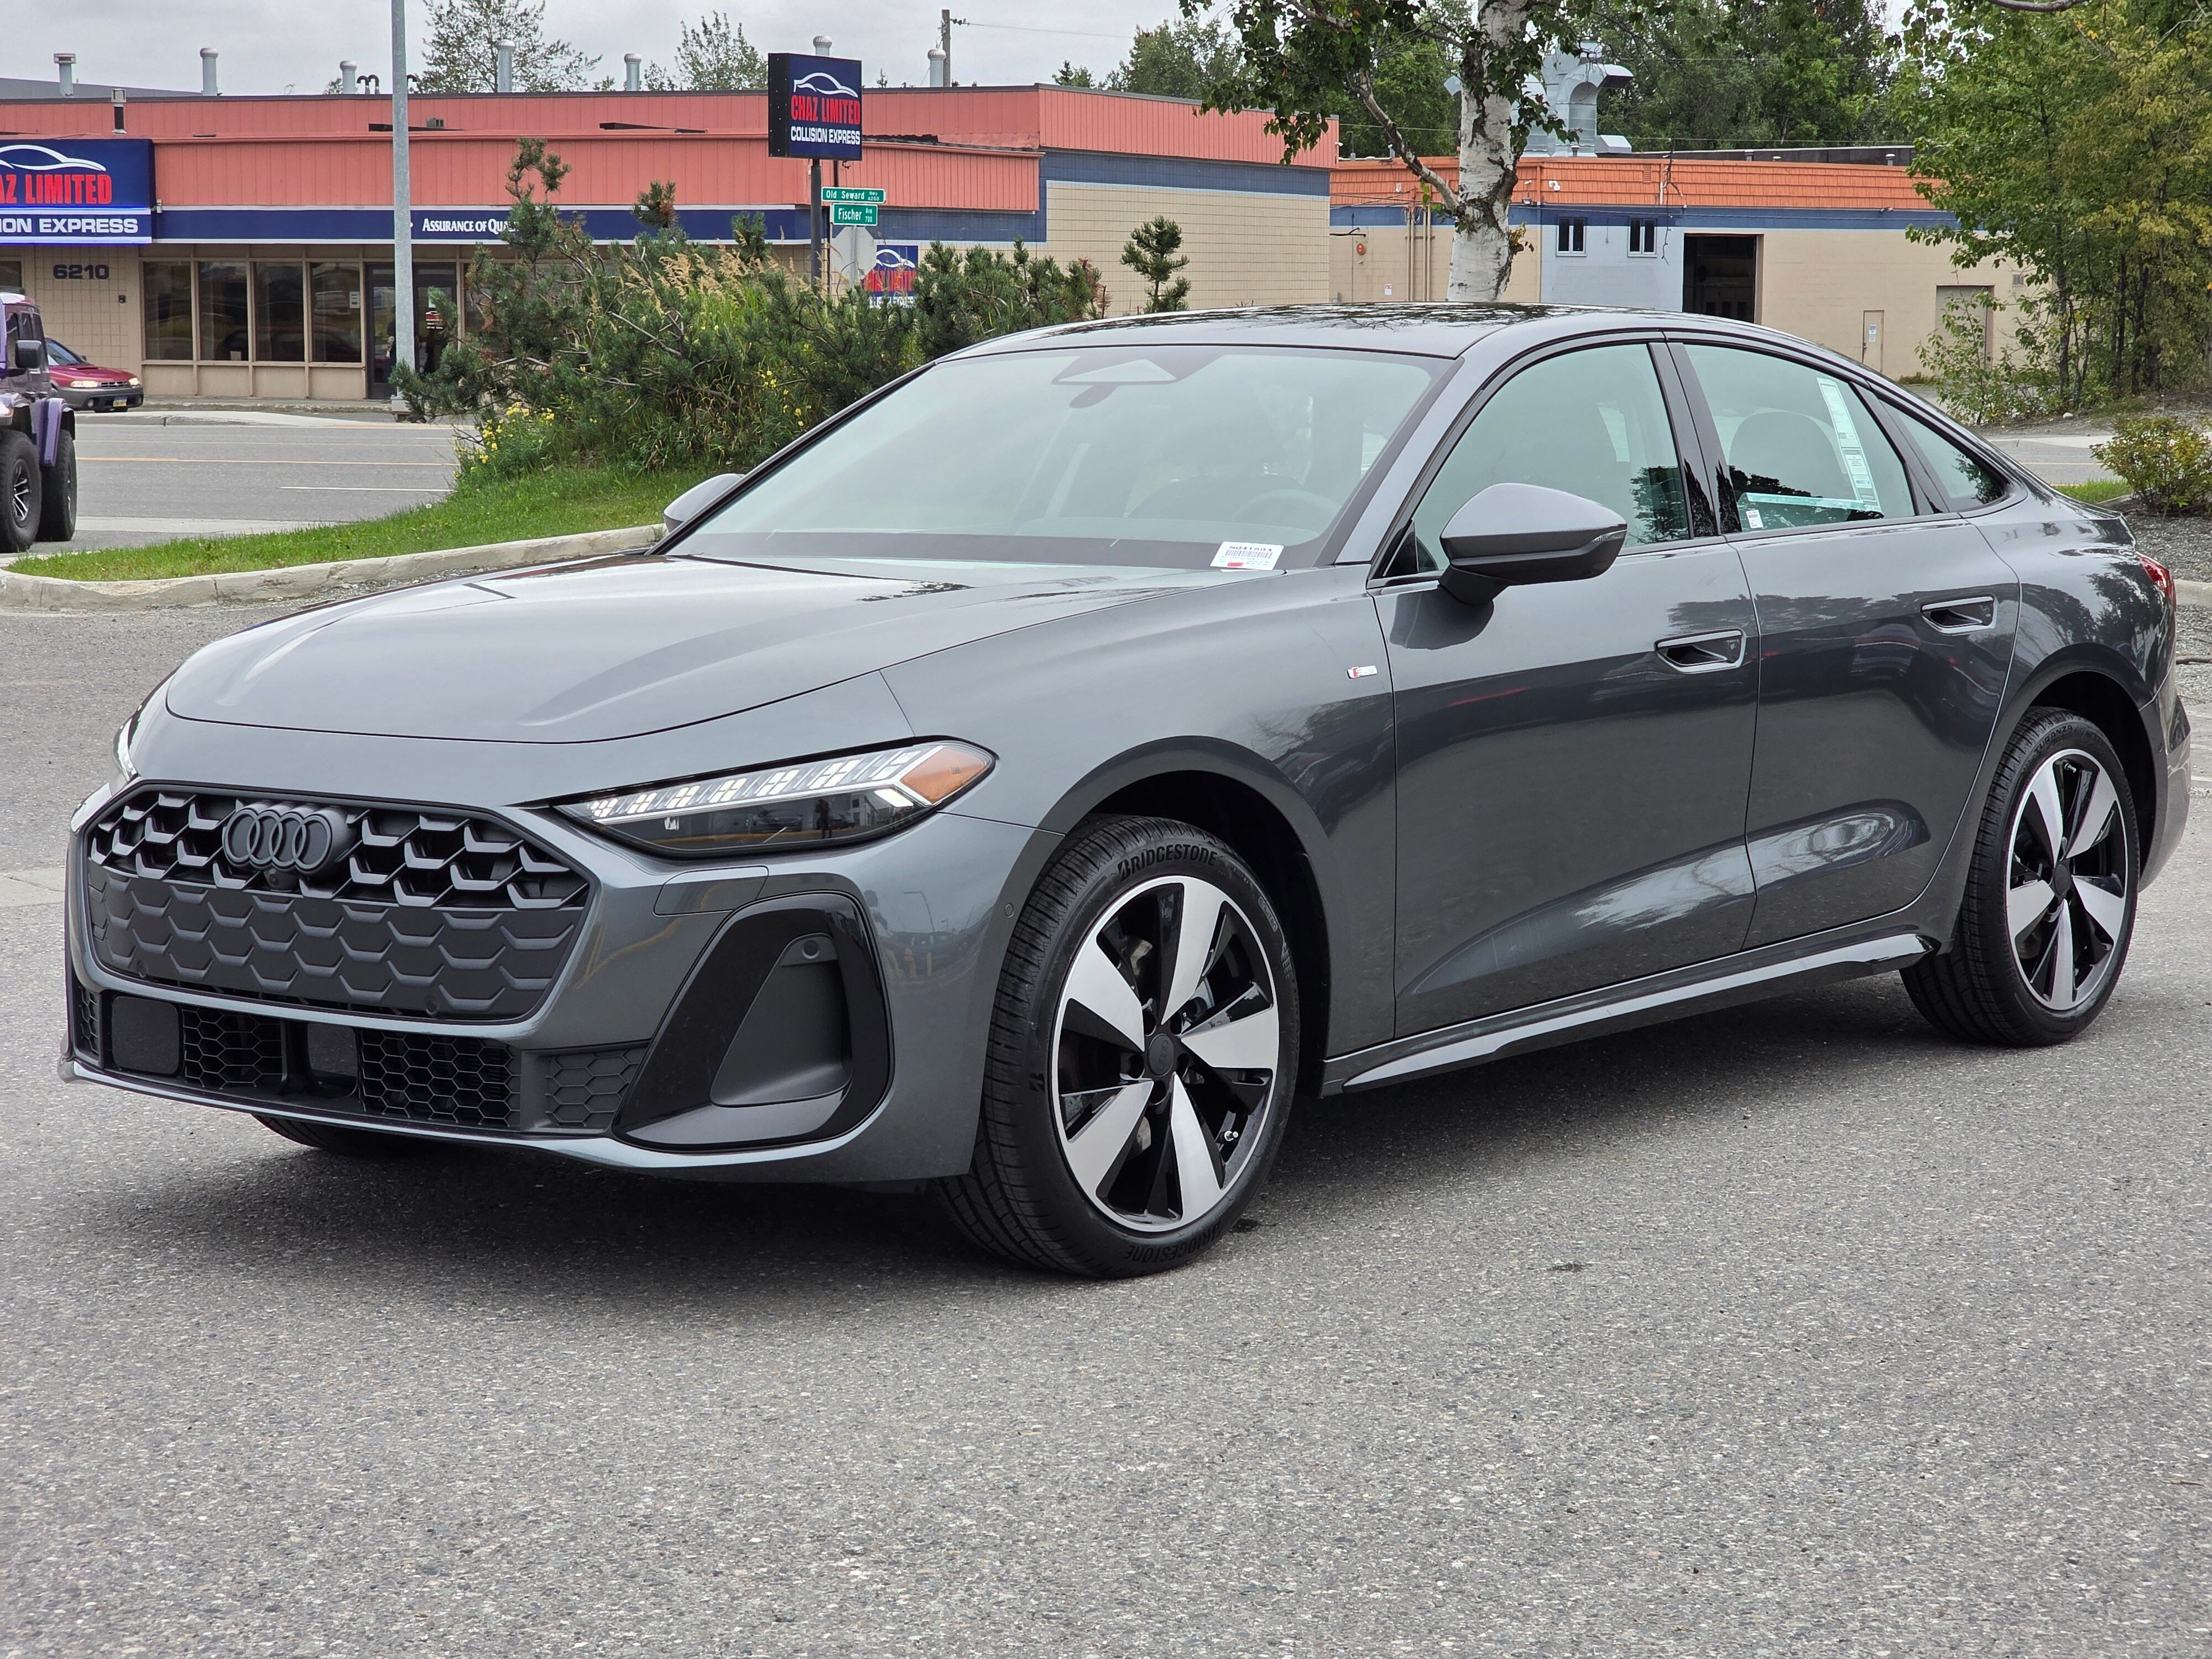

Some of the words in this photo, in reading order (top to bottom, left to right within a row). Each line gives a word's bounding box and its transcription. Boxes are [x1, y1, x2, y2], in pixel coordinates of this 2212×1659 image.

[791, 95, 818, 122] CHAZ
[821, 97, 860, 124] LIMITED
[791, 126, 827, 143] COLLISION
[829, 128, 860, 145] EXPRESS
[25, 174, 112, 204] LIMITED
[826, 190, 837, 199] Old
[841, 190, 865, 200] Seward
[39, 218, 138, 233] EXPRESS
[838, 207, 862, 221] Fischer
[53, 264, 109, 279] 6210
[2034, 724, 2073, 754] TURANZA
[1117, 843, 1218, 883] BRIDGESTONE
[1123, 1220, 1222, 1263] BRIDGESTONE
